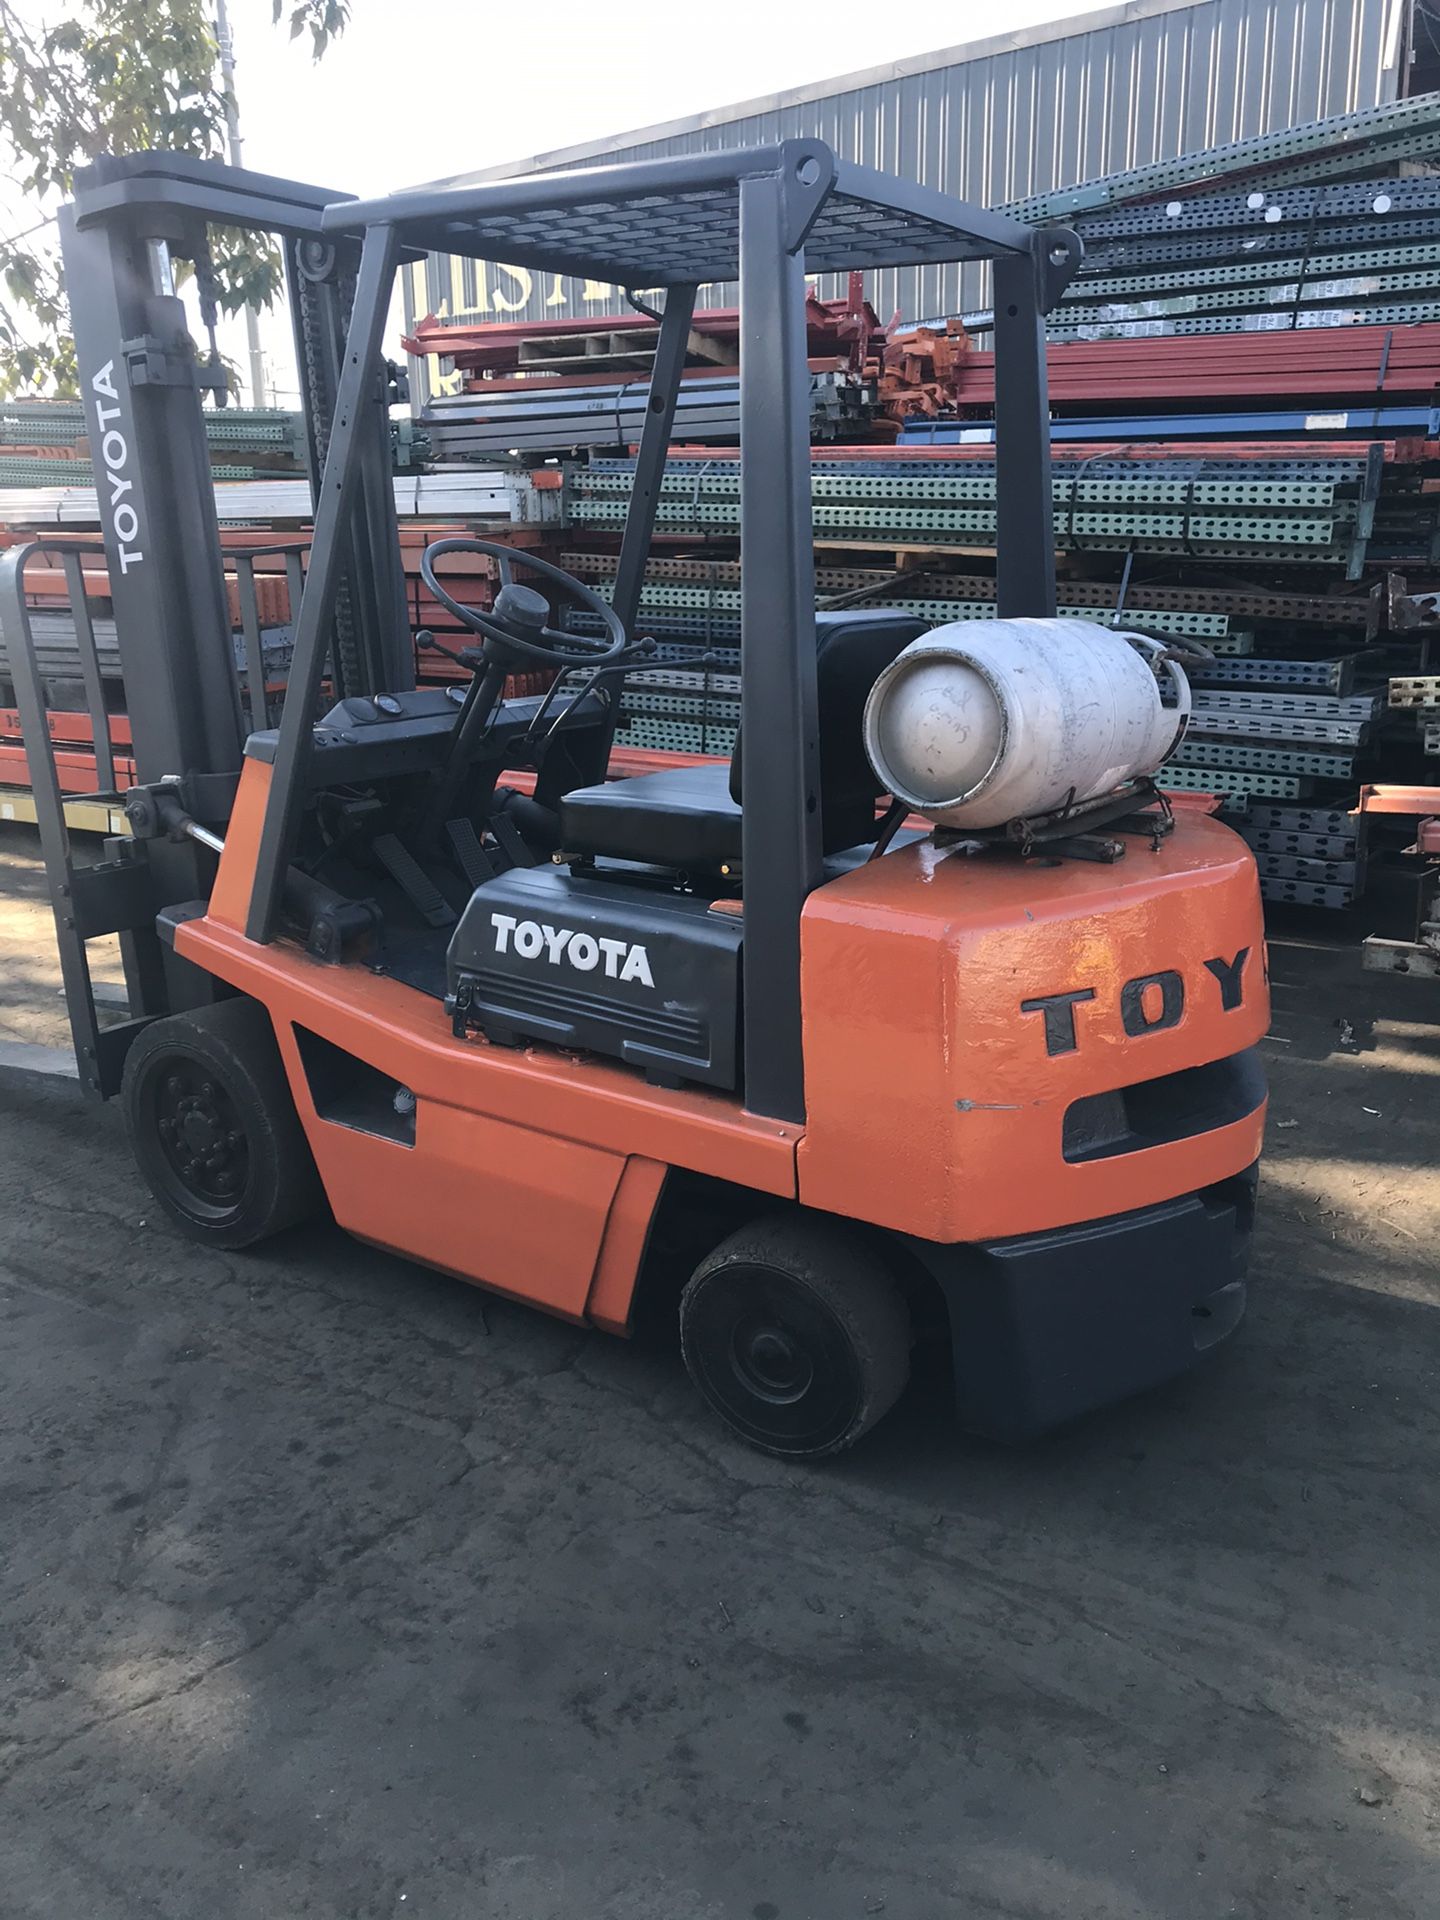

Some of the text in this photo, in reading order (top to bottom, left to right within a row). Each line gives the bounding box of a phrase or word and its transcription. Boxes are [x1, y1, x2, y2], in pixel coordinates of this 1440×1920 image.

[92, 359, 144, 575] TOYOTA
[491, 913, 655, 988] TOYOTA
[1020, 940, 1268, 1057] TOY
